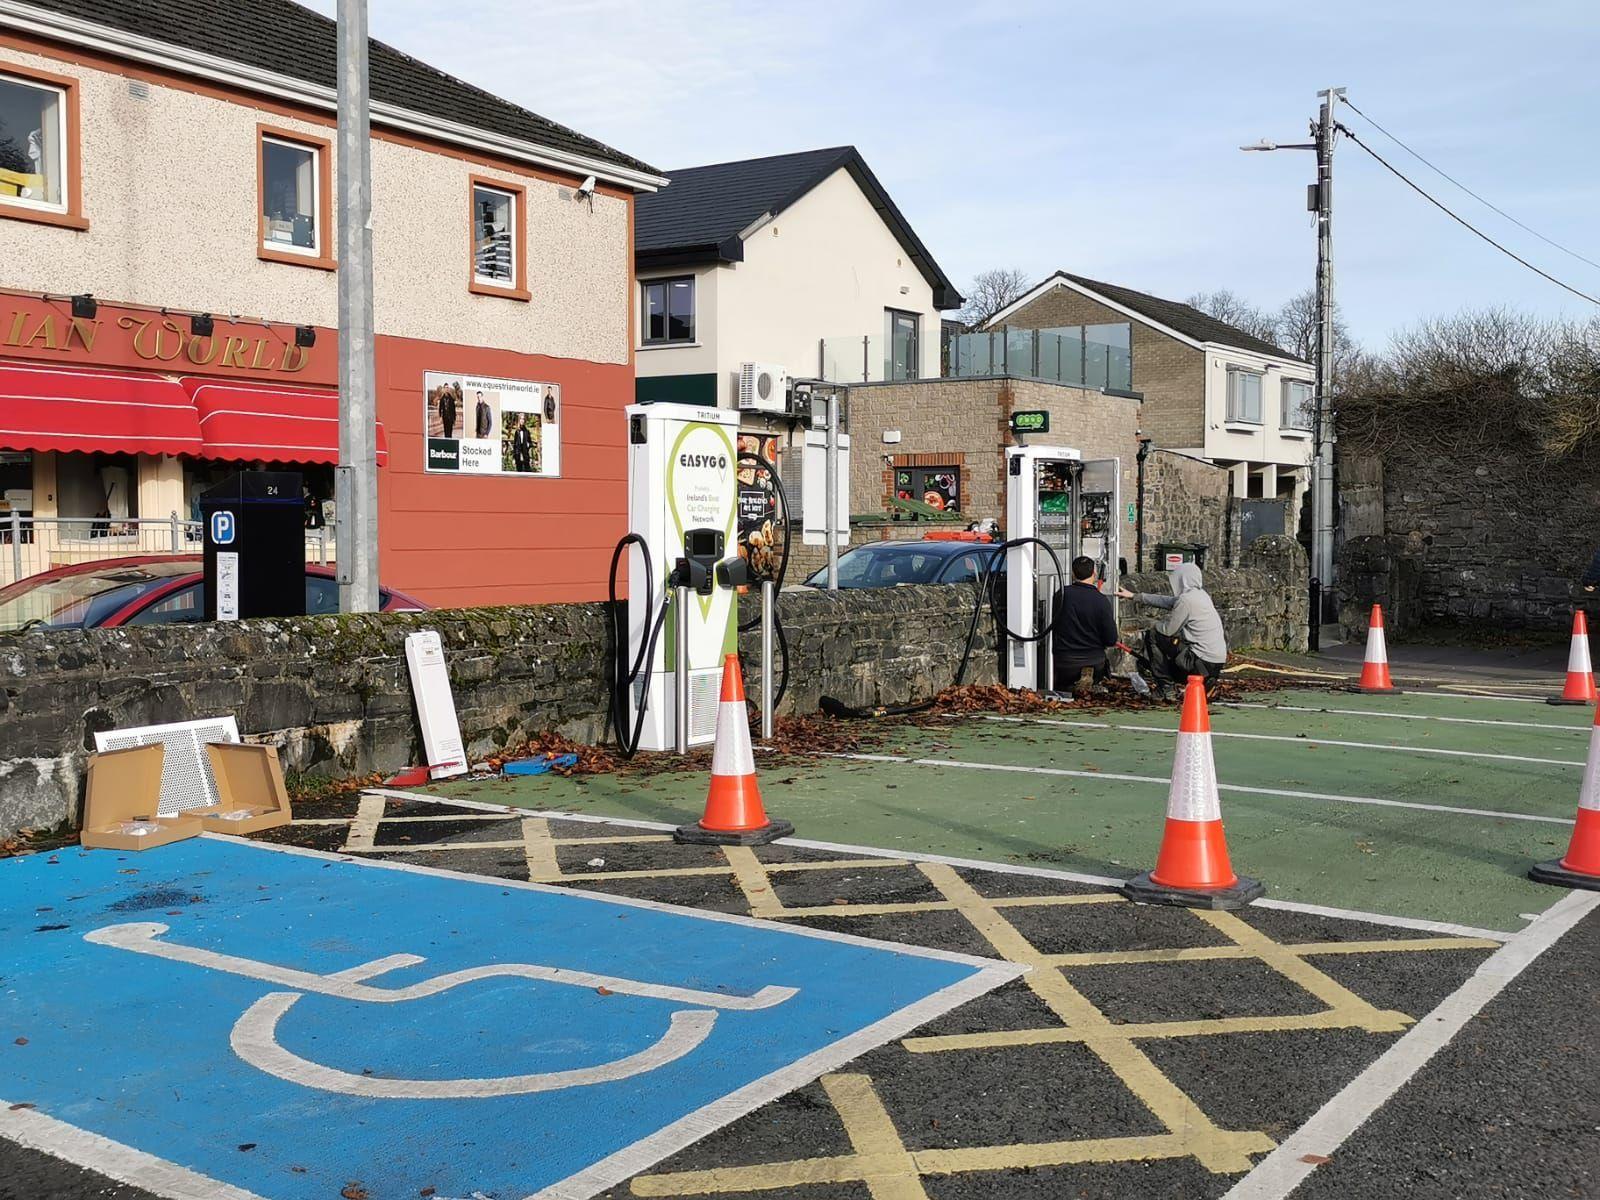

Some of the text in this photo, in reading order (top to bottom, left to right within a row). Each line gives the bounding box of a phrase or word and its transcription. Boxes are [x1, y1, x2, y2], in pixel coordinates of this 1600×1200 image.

[466, 381, 539, 394] www.equestrianworld.ie
[697, 411, 720, 420] TRITIUM
[430, 449, 457, 459] Barbour
[462, 445, 492, 456] Stocked
[462, 458, 480, 467] Here
[267, 486, 279, 495] 24
[692, 515, 715, 523] Network
[217, 516, 229, 539] P
